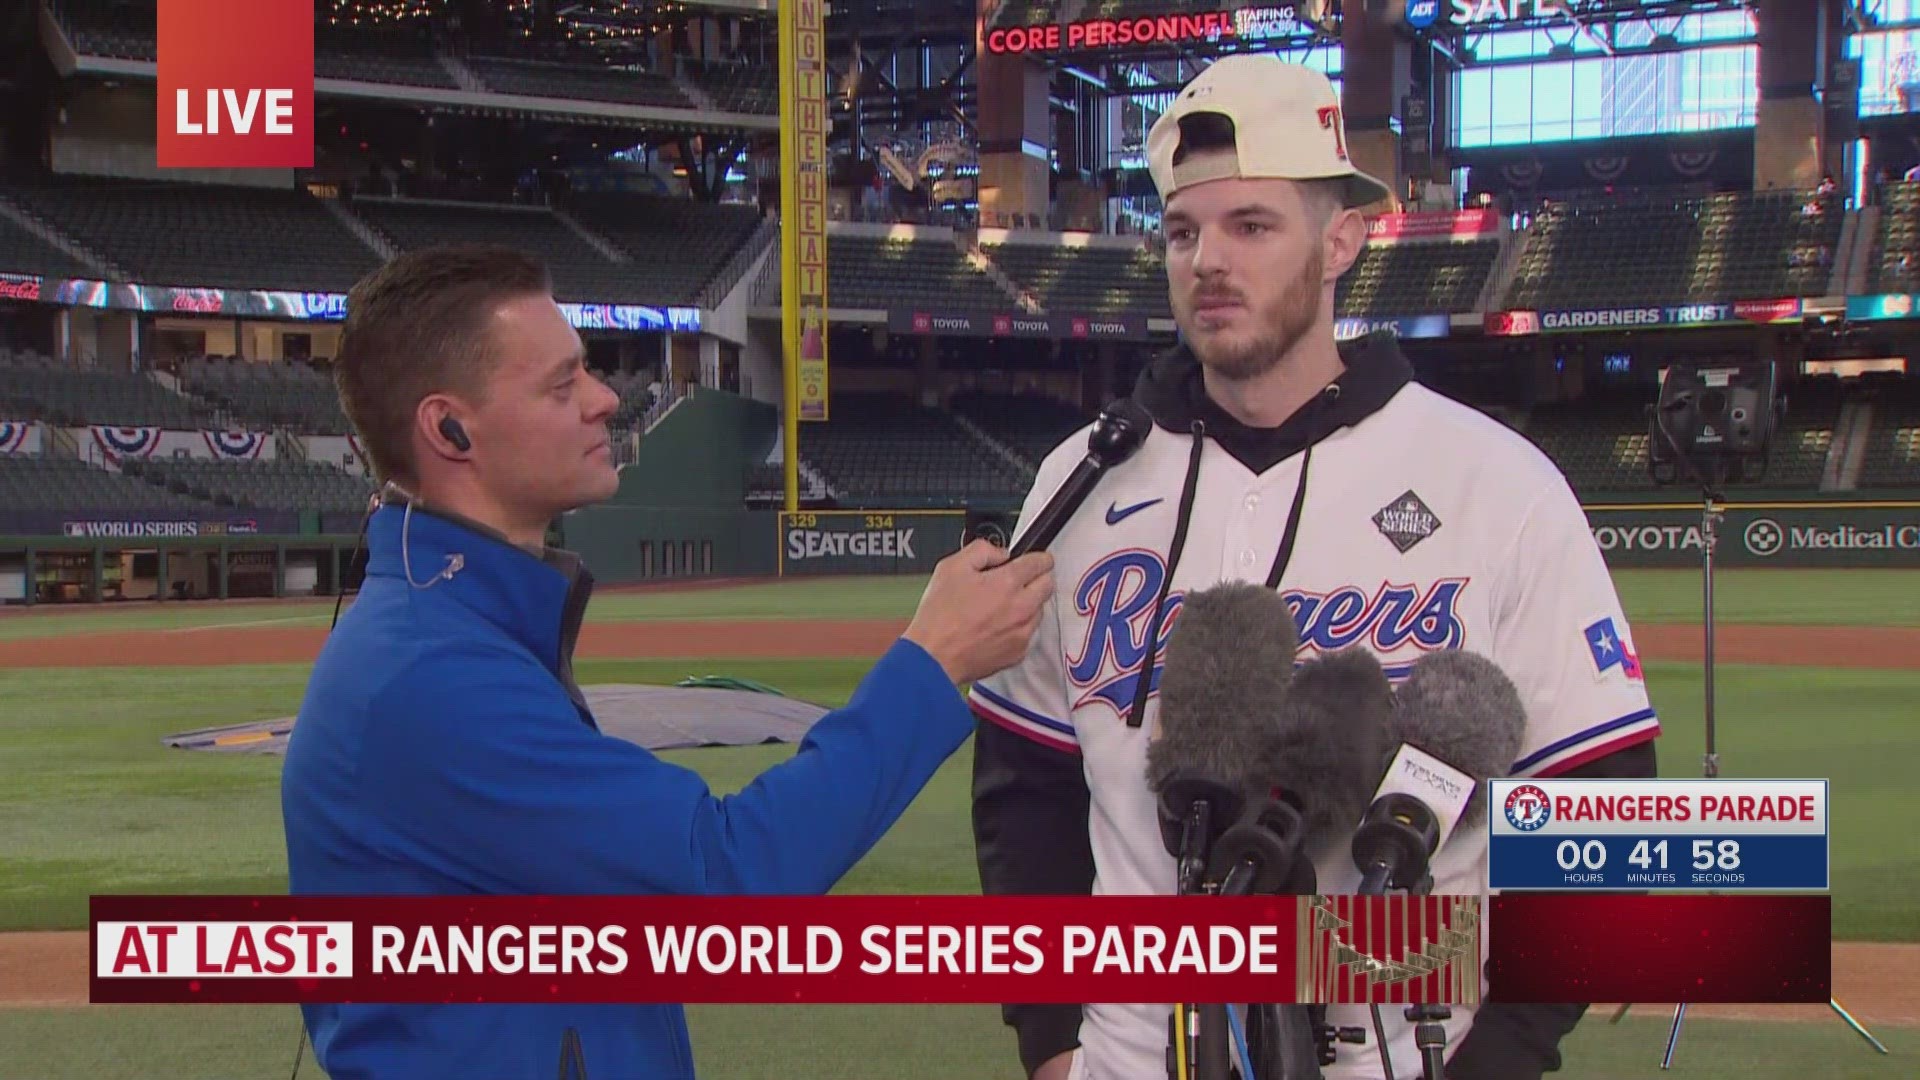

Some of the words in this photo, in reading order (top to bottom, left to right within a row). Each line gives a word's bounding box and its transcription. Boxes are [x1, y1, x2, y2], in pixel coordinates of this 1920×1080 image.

[1235, 6, 1295, 22] STAFFING
[1411, 4, 1434, 17] ADT
[988, 26, 1060, 53] CORE
[1067, 10, 1235, 48] PERSONNEL
[932, 318, 970, 330] TOYOTA
[1543, 308, 1660, 329] GARDENERS
[1665, 304, 1729, 324] TRUST
[1012, 320, 1050, 332] TOYOTA
[1090, 322, 1126, 334] TOYOTA
[788, 515, 817, 528] 329
[865, 515, 895, 529] 334
[1381, 508, 1433, 524] WORLD
[86, 521, 144, 537] WORLD
[145, 521, 198, 537] SERIES
[1380, 519, 1431, 535] SERIES
[787, 528, 916, 560] SEATGEEK
[1790, 524, 1894, 549] Medical
